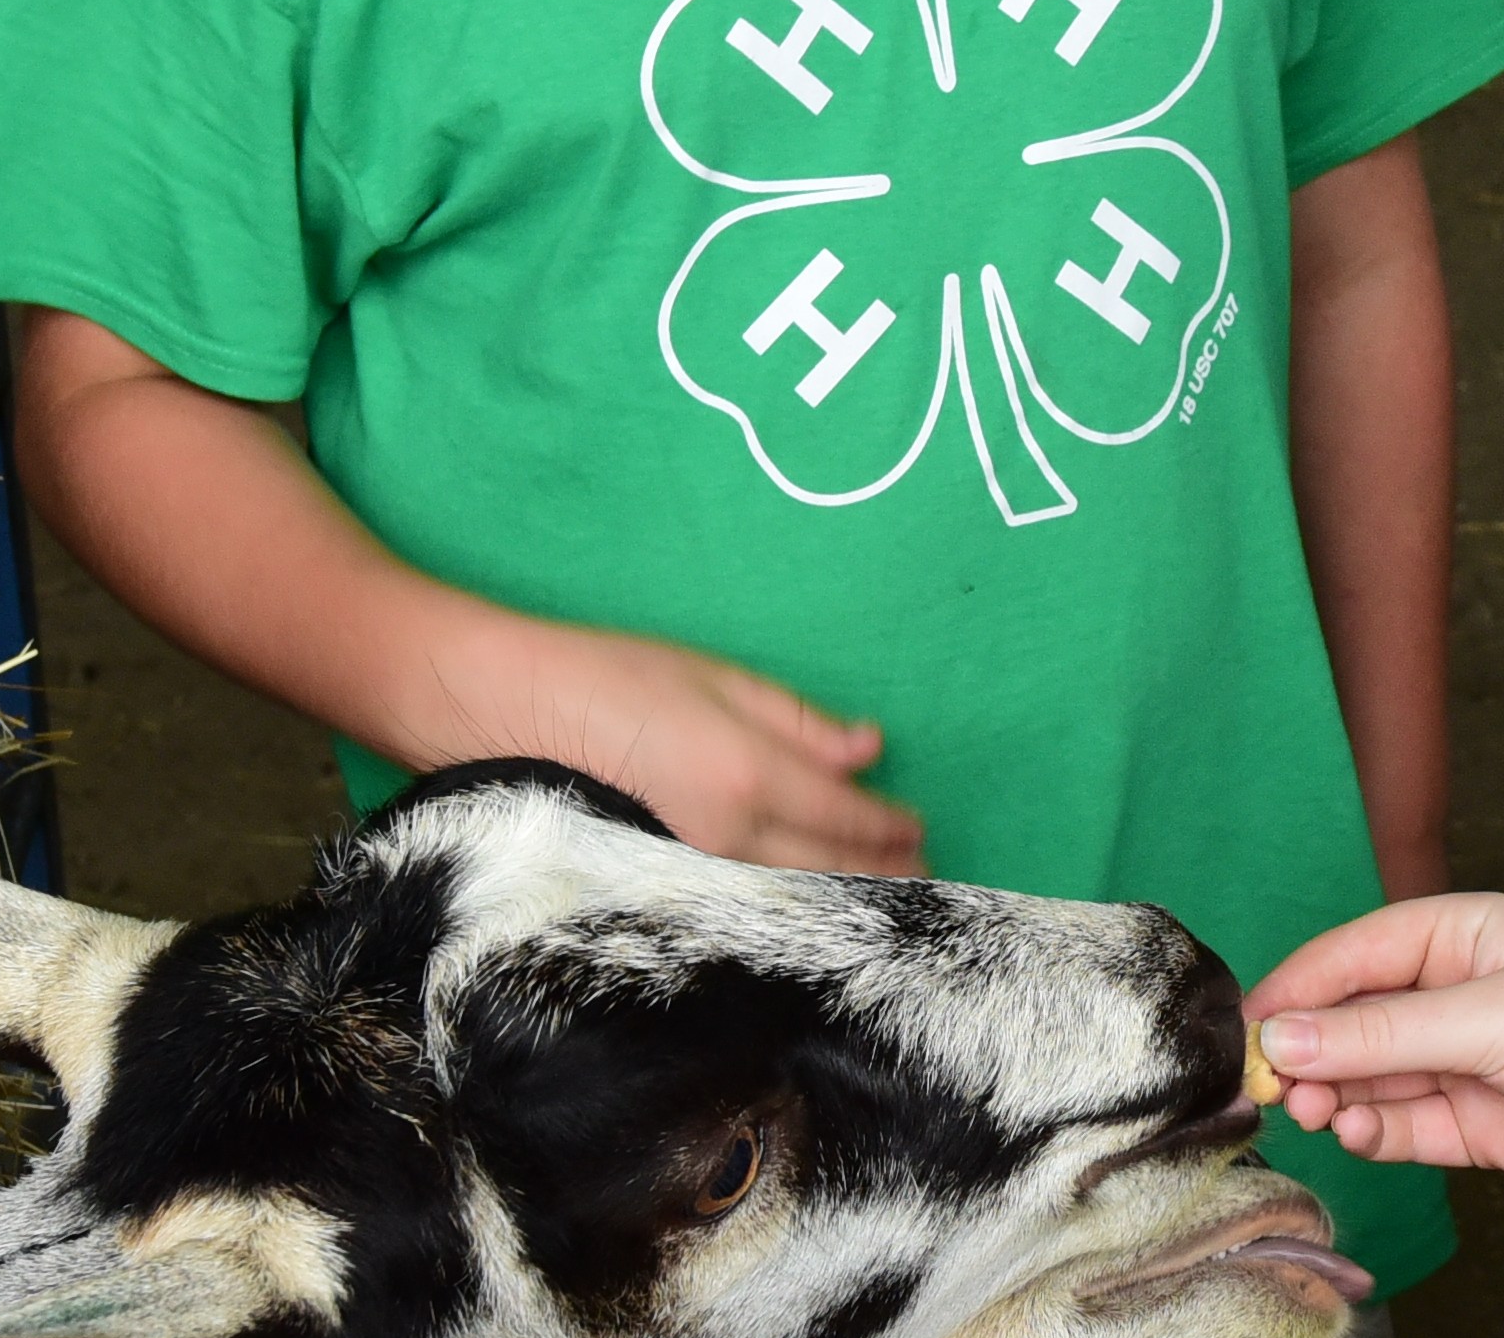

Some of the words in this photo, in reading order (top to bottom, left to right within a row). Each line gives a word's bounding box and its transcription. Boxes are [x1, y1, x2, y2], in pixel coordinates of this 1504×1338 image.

[742, 248, 896, 408] H
[1055, 197, 1181, 345] H
[1179, 395, 1196, 425] 18
[1188, 339, 1218, 394] USC
[1212, 292, 1238, 339] 707
